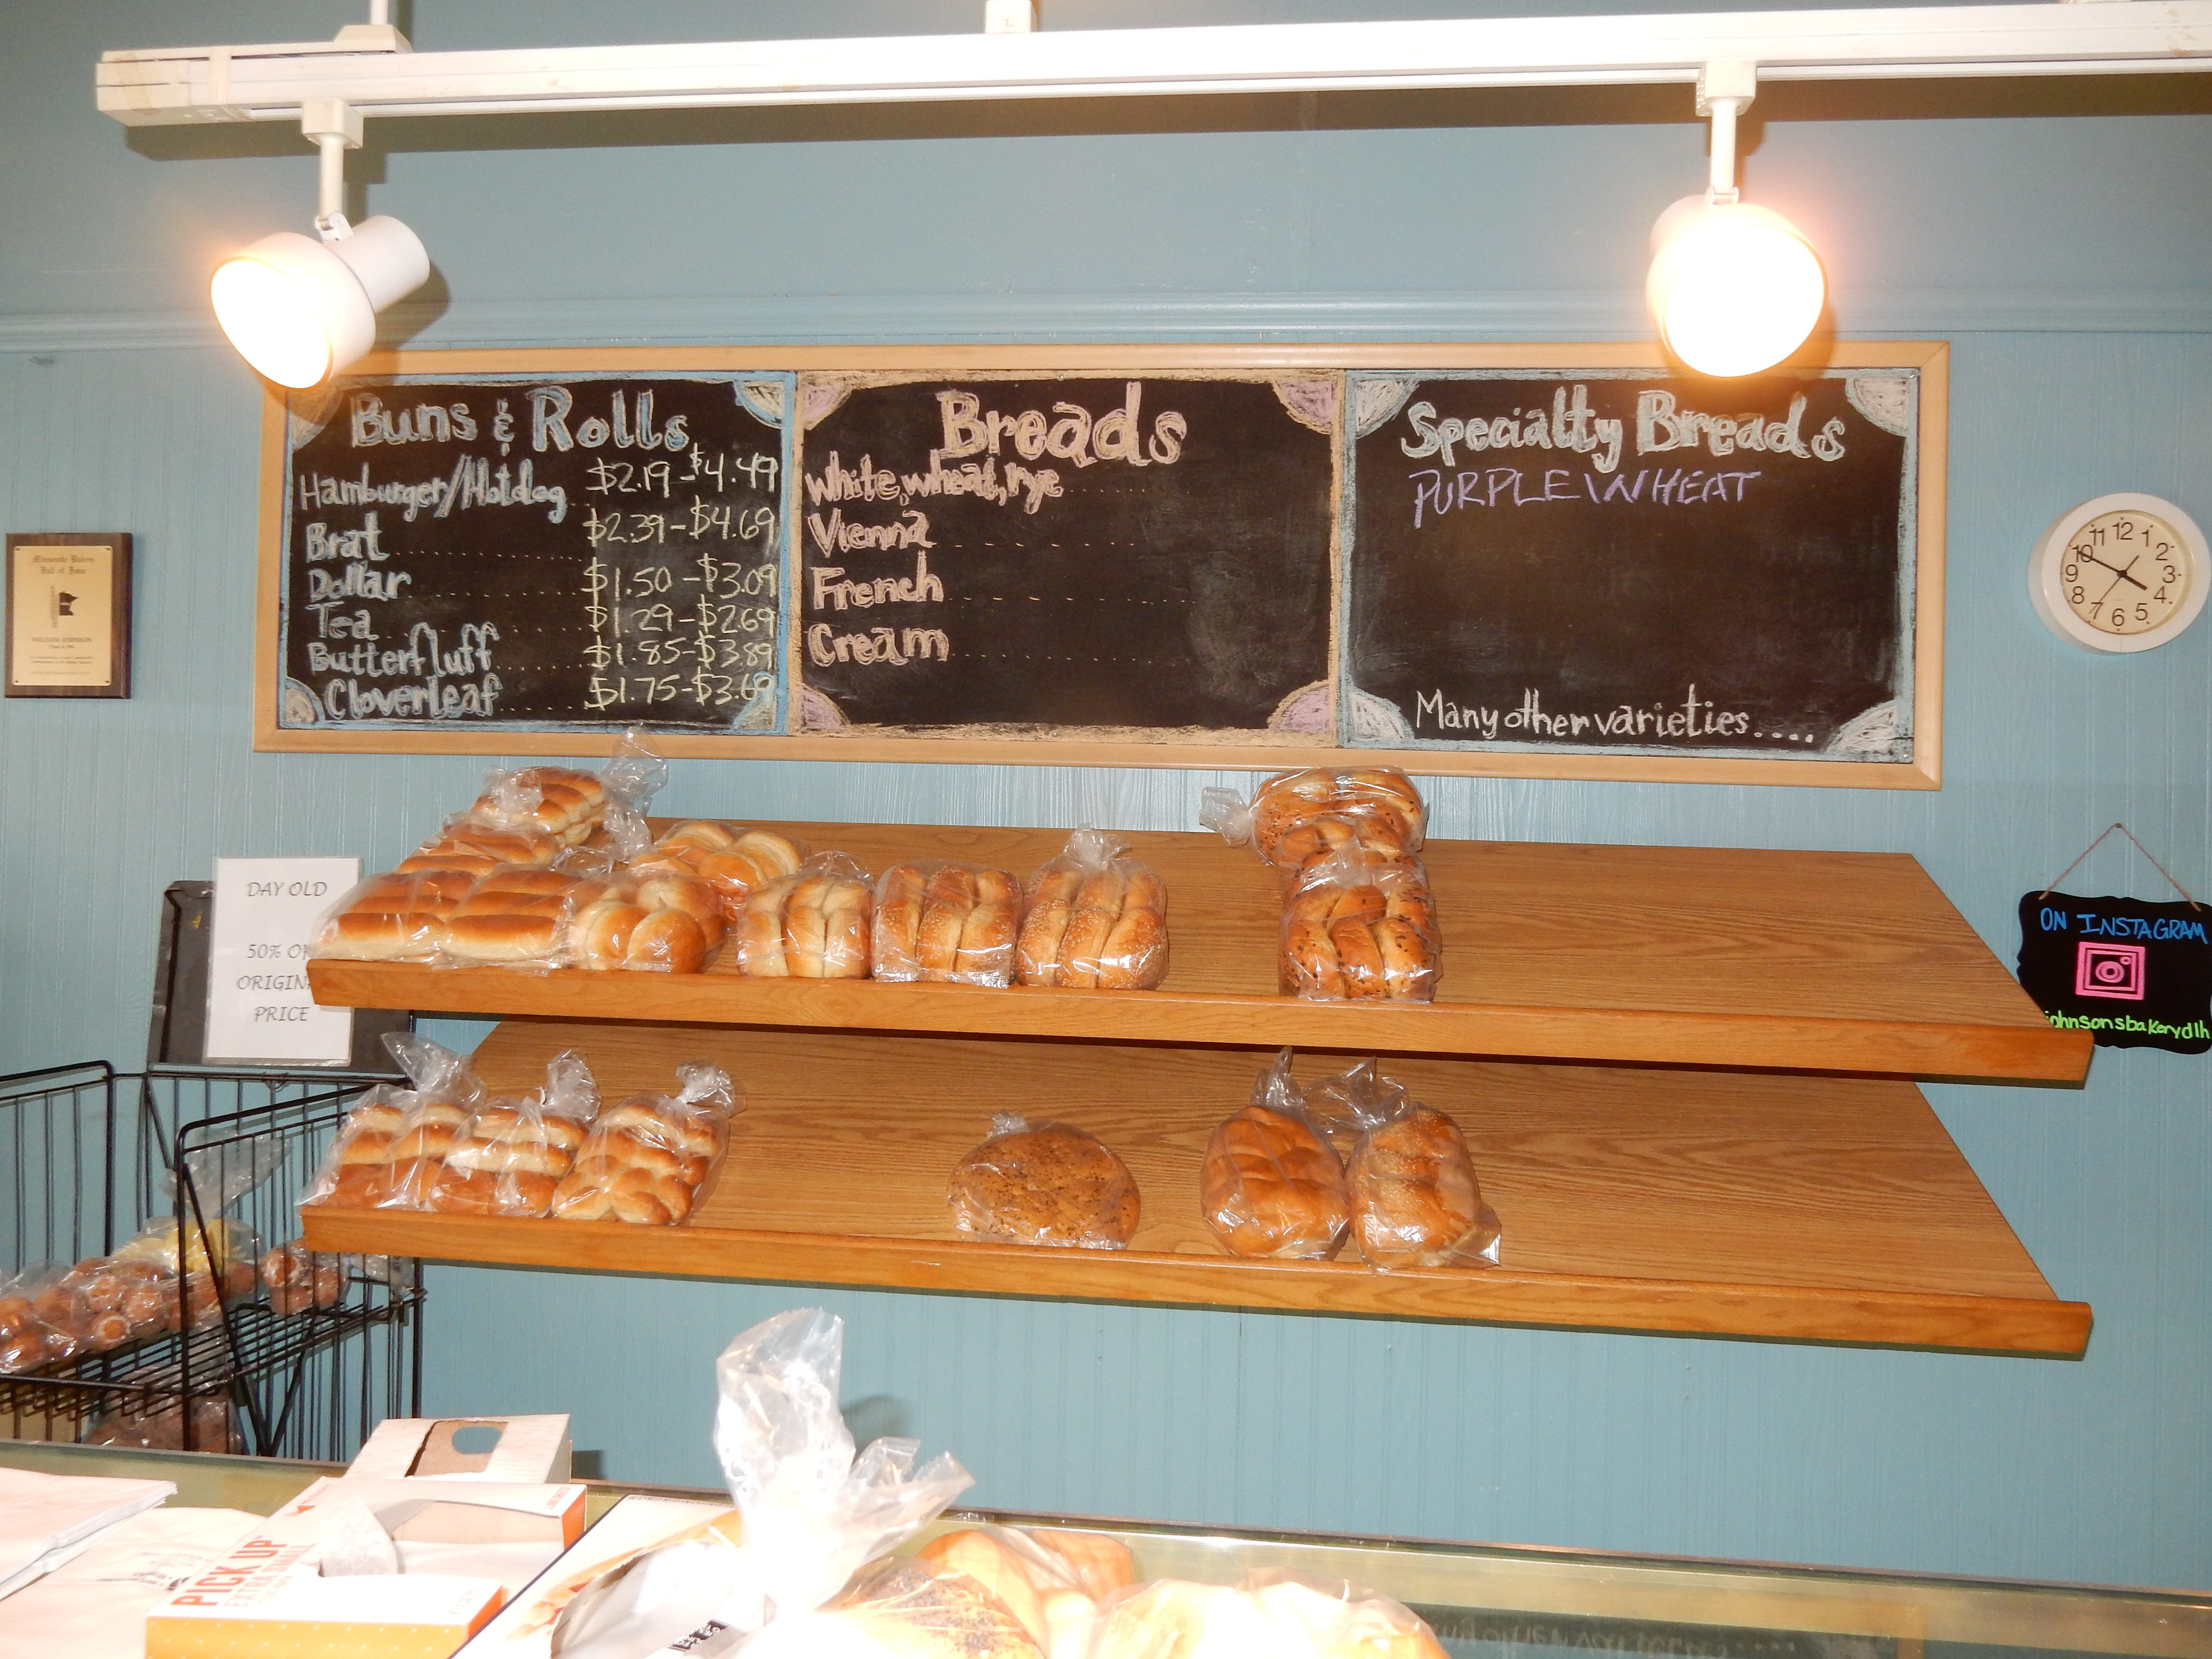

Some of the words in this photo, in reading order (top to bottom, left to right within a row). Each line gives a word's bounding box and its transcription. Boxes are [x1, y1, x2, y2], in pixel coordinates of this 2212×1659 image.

[351, 392, 478, 448] Buns
[526, 385, 690, 452] Rolls
[937, 381, 1187, 468] Breads
[1401, 385, 1623, 473] Specialty
[1636, 389, 1845, 462] Breads
[1408, 468, 1581, 529] PURPLE
[1584, 468, 1762, 505] WHEAT
[306, 511, 390, 563] Brat
[807, 508, 937, 558] Vienna
[2089, 528, 2105, 546] 11
[2112, 522, 2133, 540] 12
[2141, 529, 2150, 547] 1
[2071, 544, 2093, 562] 10
[2155, 542, 2168, 561] 2
[309, 560, 412, 602] Dollar
[809, 550, 944, 611] French
[2065, 564, 2079, 582] 9
[2162, 565, 2176, 584] 3
[2071, 586, 2085, 604] 8
[2153, 586, 2167, 604] 4
[305, 601, 379, 640] Tea
[2091, 602, 2104, 620] 7
[2112, 608, 2125, 626] 6
[2135, 603, 2148, 621] 5
[808, 624, 950, 667] Cream
[324, 673, 503, 720] Cloverleaf
[1416, 688, 1499, 740] Many
[1504, 687, 1589, 736] other
[248, 881, 285, 897] DAY
[289, 881, 327, 897] OLD
[2041, 907, 2067, 931] ON
[2076, 914, 2208, 944] INSTAGRAM
[248, 944, 281, 959] 50%
[237, 975, 311, 991] ORIGIN
[254, 1007, 310, 1022] PRICE
[169, 1564, 263, 1606] PICK
[229, 1540, 288, 1559] UP
